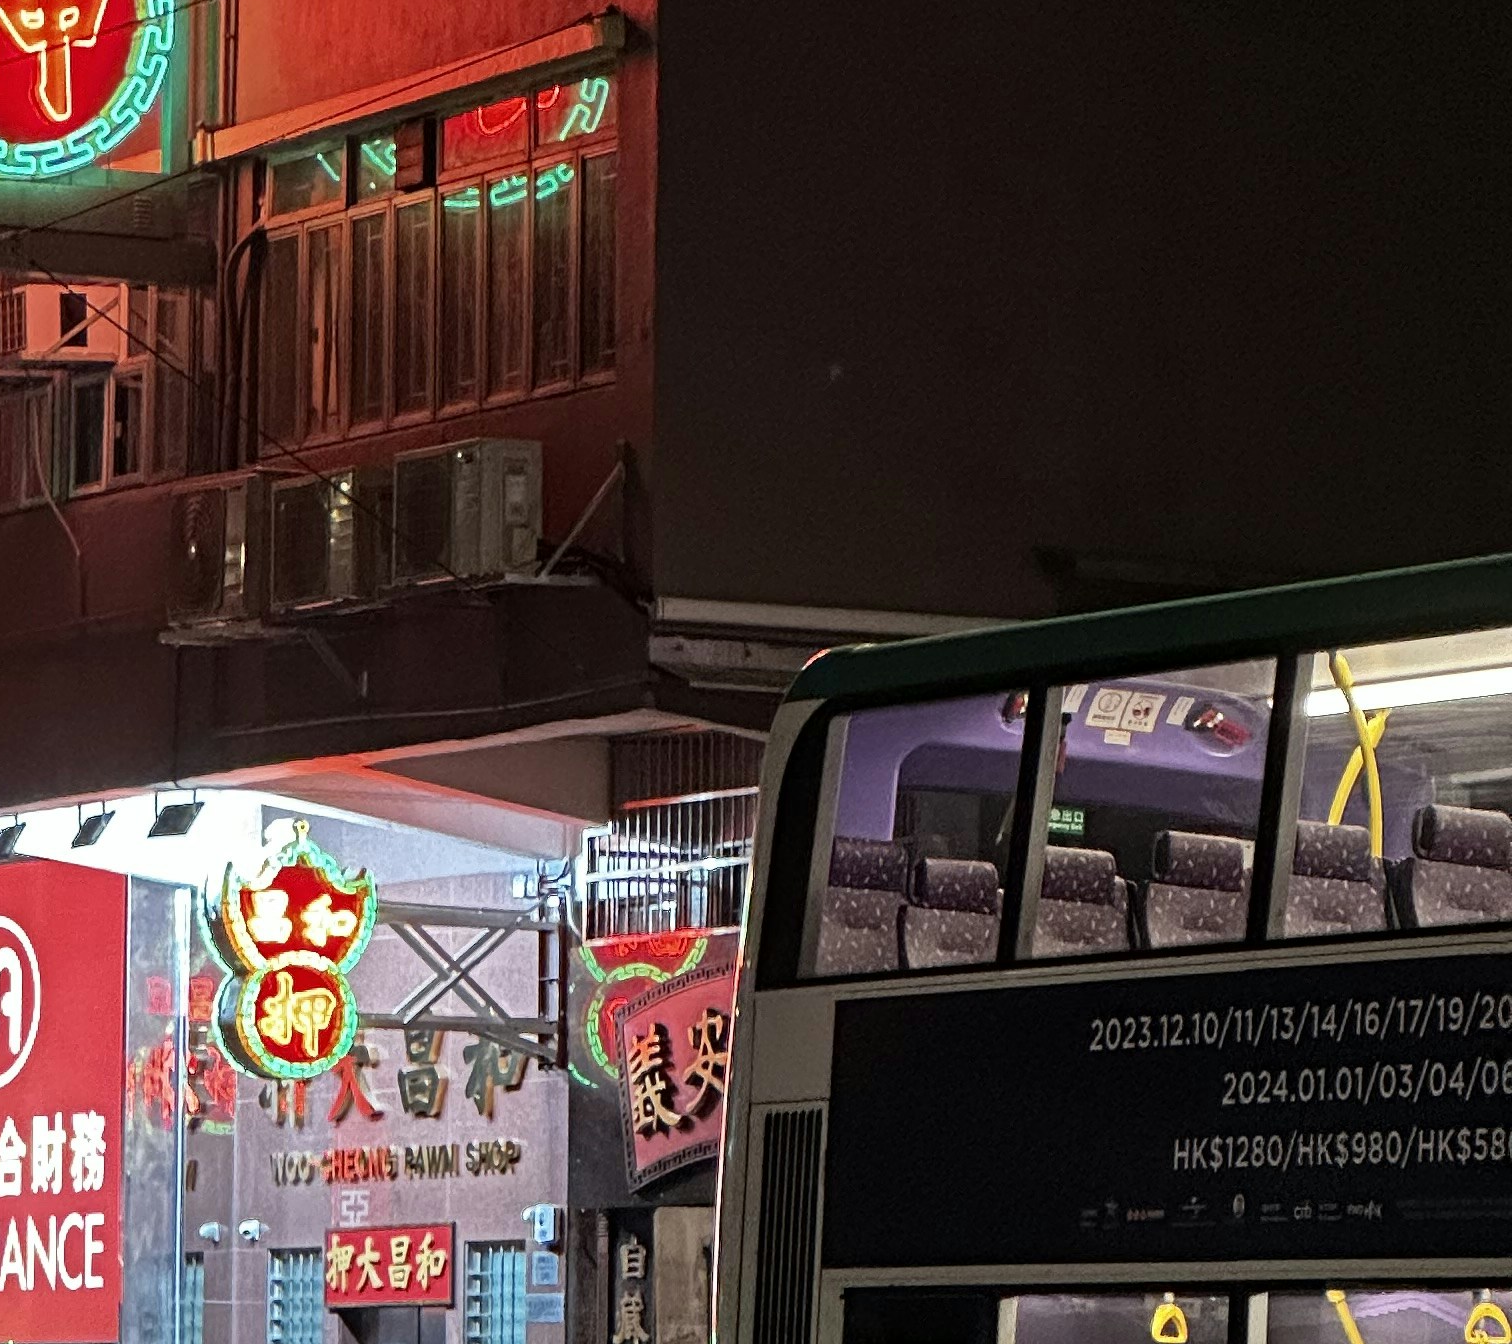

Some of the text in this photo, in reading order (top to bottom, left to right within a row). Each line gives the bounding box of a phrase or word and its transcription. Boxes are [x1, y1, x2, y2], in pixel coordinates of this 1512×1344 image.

[257, 971, 336, 1058] 押
[322, 1144, 399, 1185] CHEONG
[404, 1142, 461, 1182] PAWN
[465, 1137, 522, 1177] SHOP
[1172, 1125, 1512, 1173] HK$1280/HK$980/HK$58
